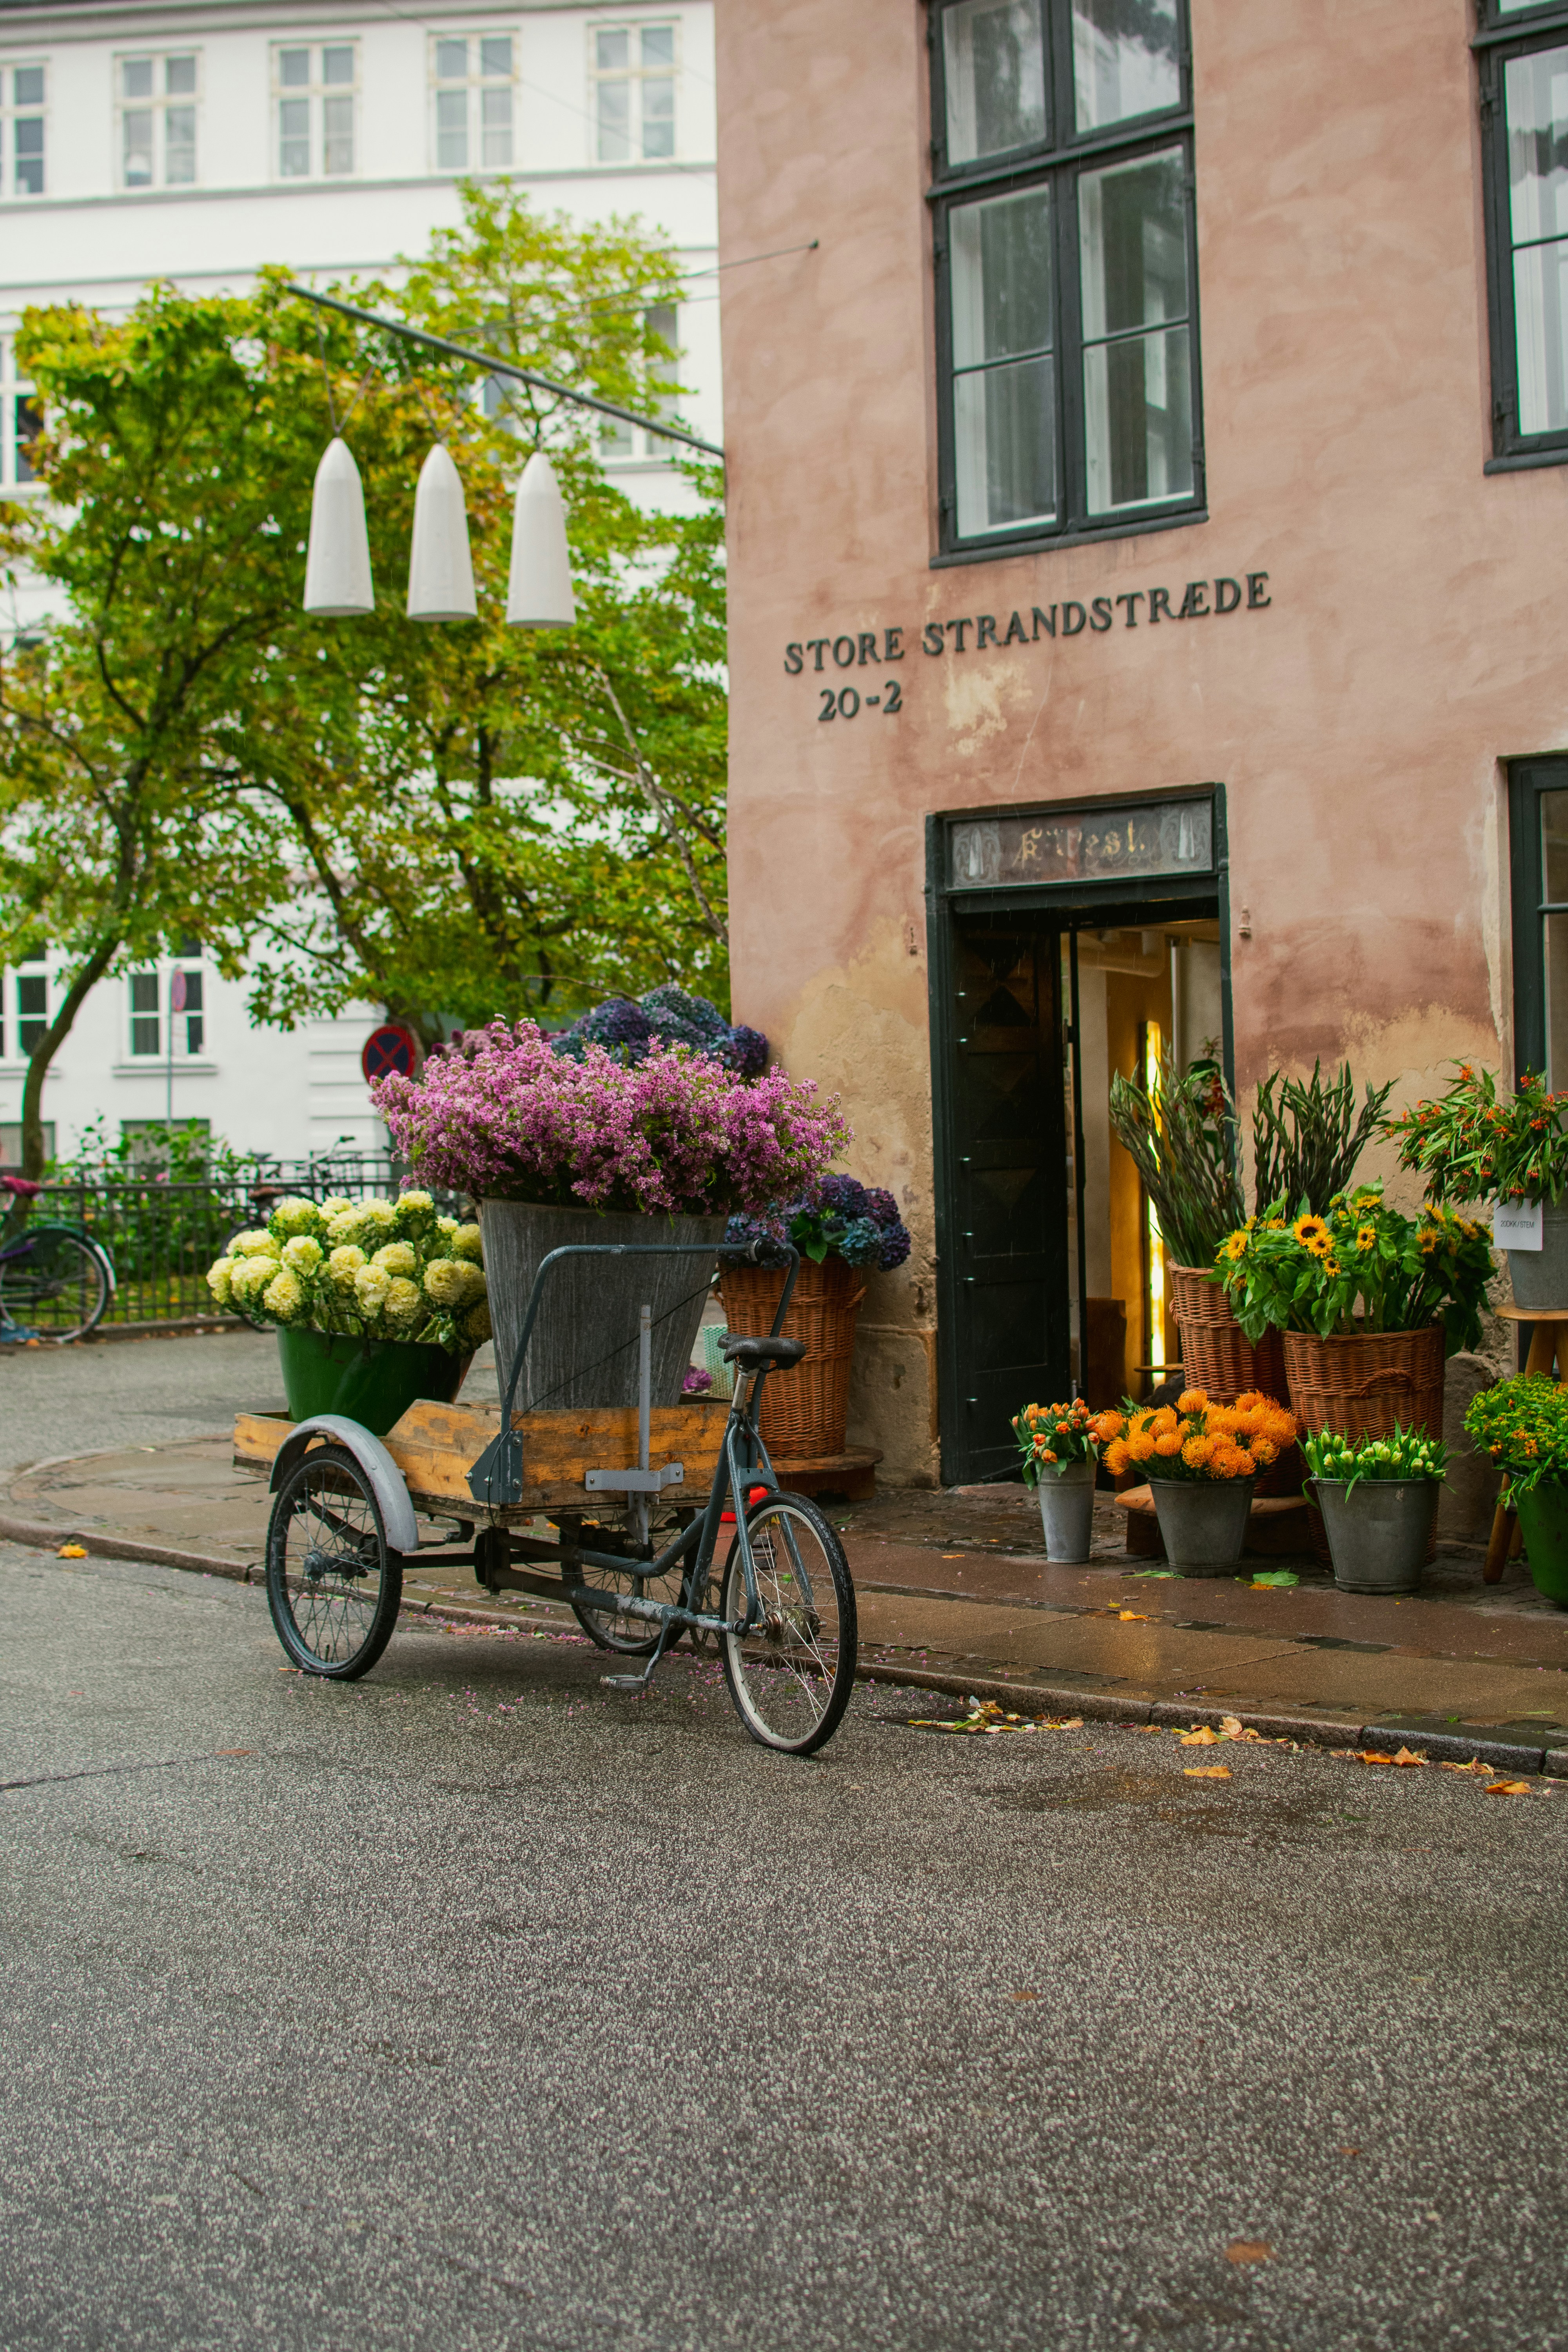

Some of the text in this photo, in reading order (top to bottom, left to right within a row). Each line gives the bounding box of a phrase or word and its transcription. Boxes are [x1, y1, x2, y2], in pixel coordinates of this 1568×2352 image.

[784, 571, 1272, 675] STORE STRANDSTRÆDE
[818, 680, 903, 721] 20-2
